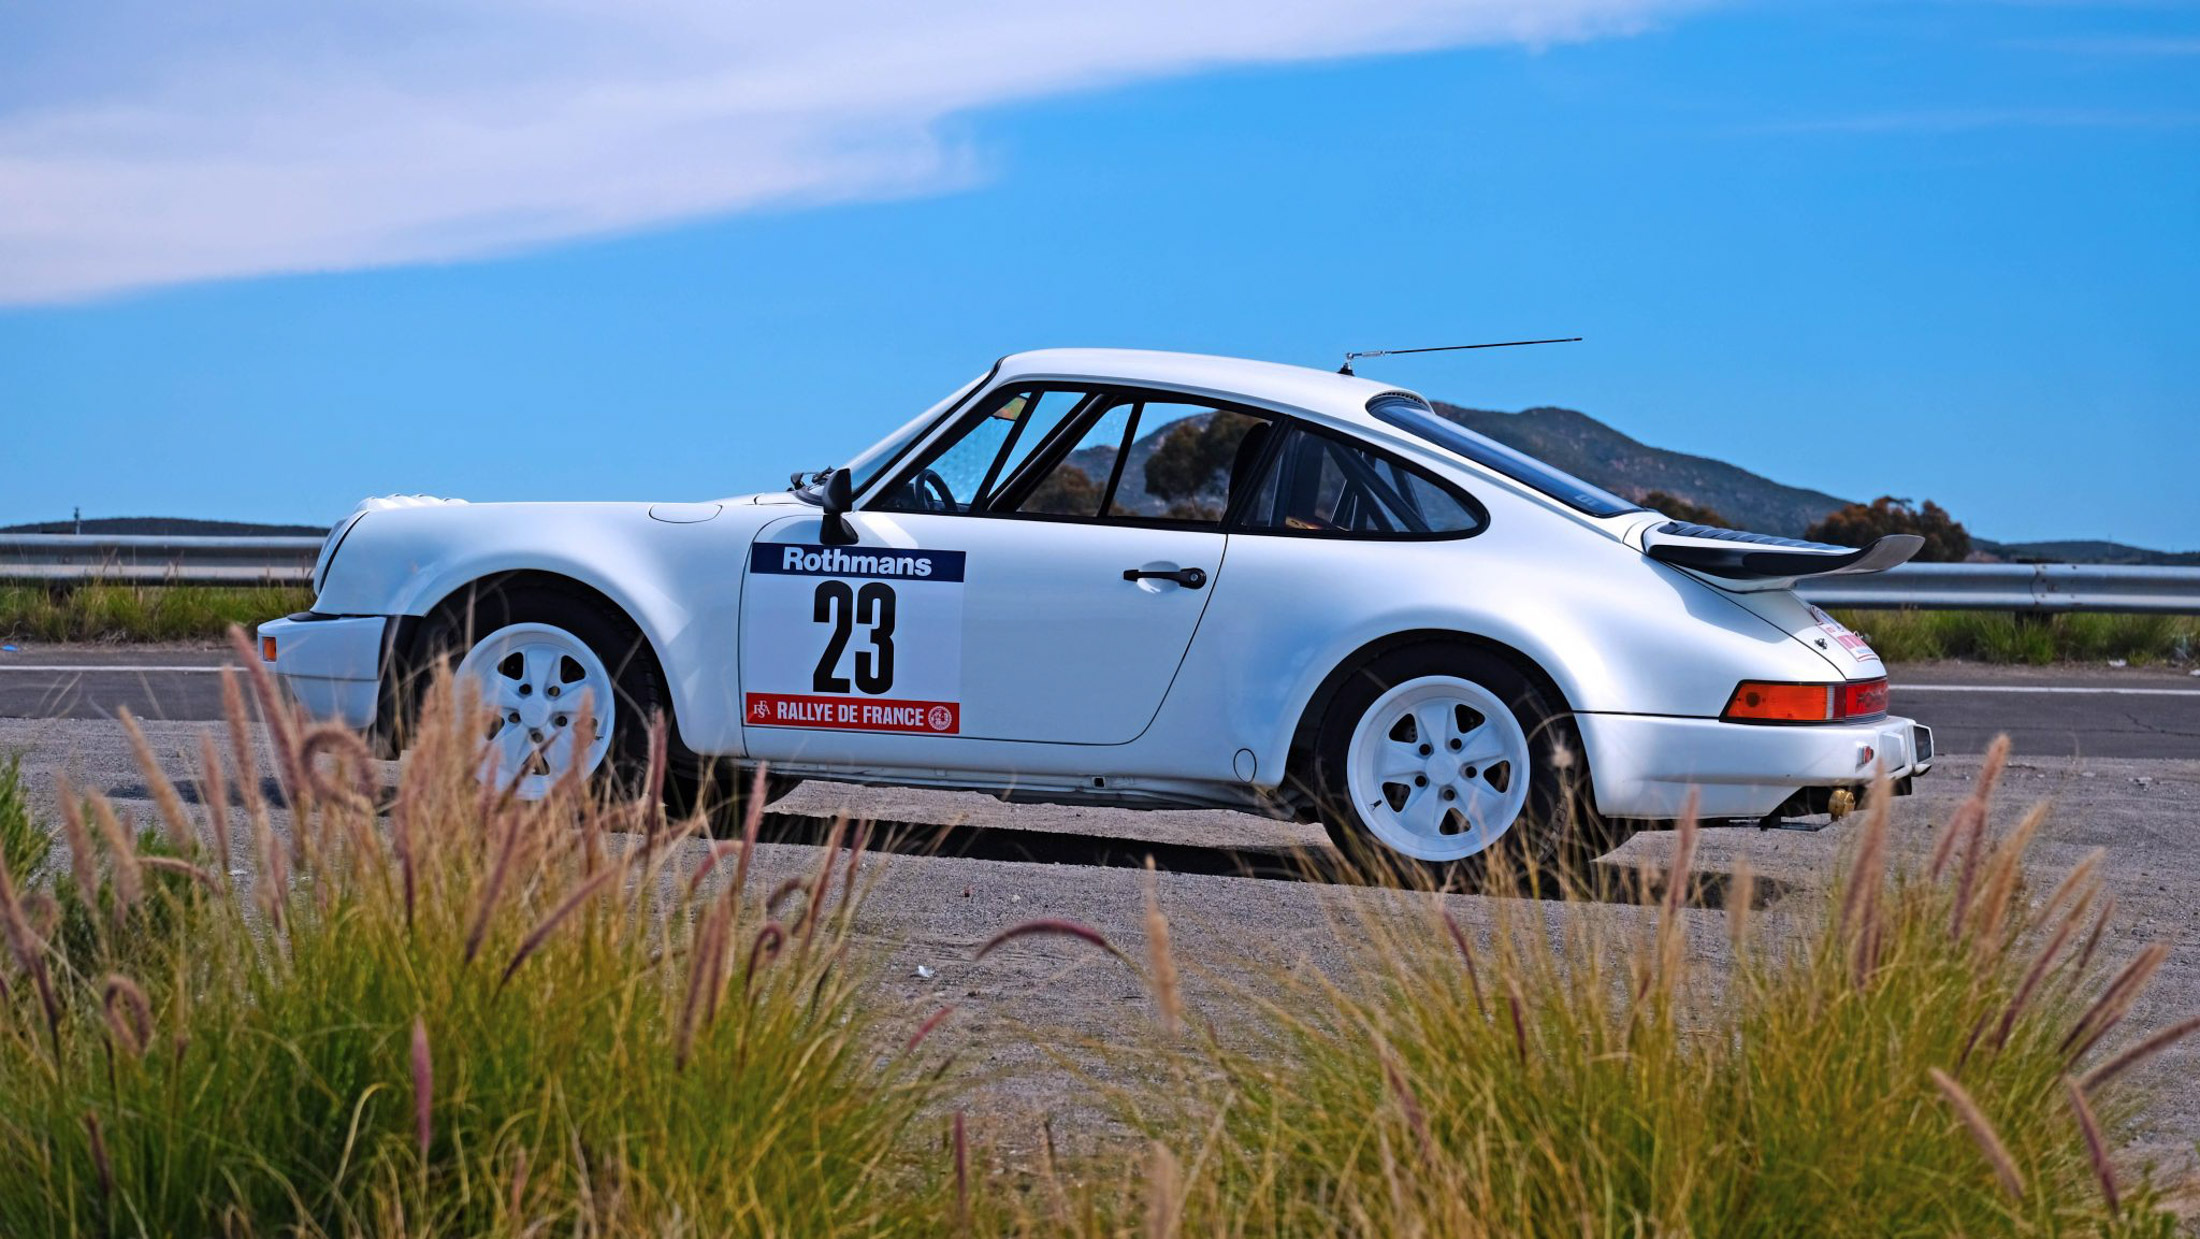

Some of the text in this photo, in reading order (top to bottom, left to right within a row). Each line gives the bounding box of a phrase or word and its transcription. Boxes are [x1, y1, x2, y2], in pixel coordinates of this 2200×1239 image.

[782, 546, 932, 576] Rothmans
[813, 579, 896, 695] 23
[777, 701, 833, 721] RALLYE
[838, 704, 858, 723] DE
[863, 705, 924, 726] FRANCE
